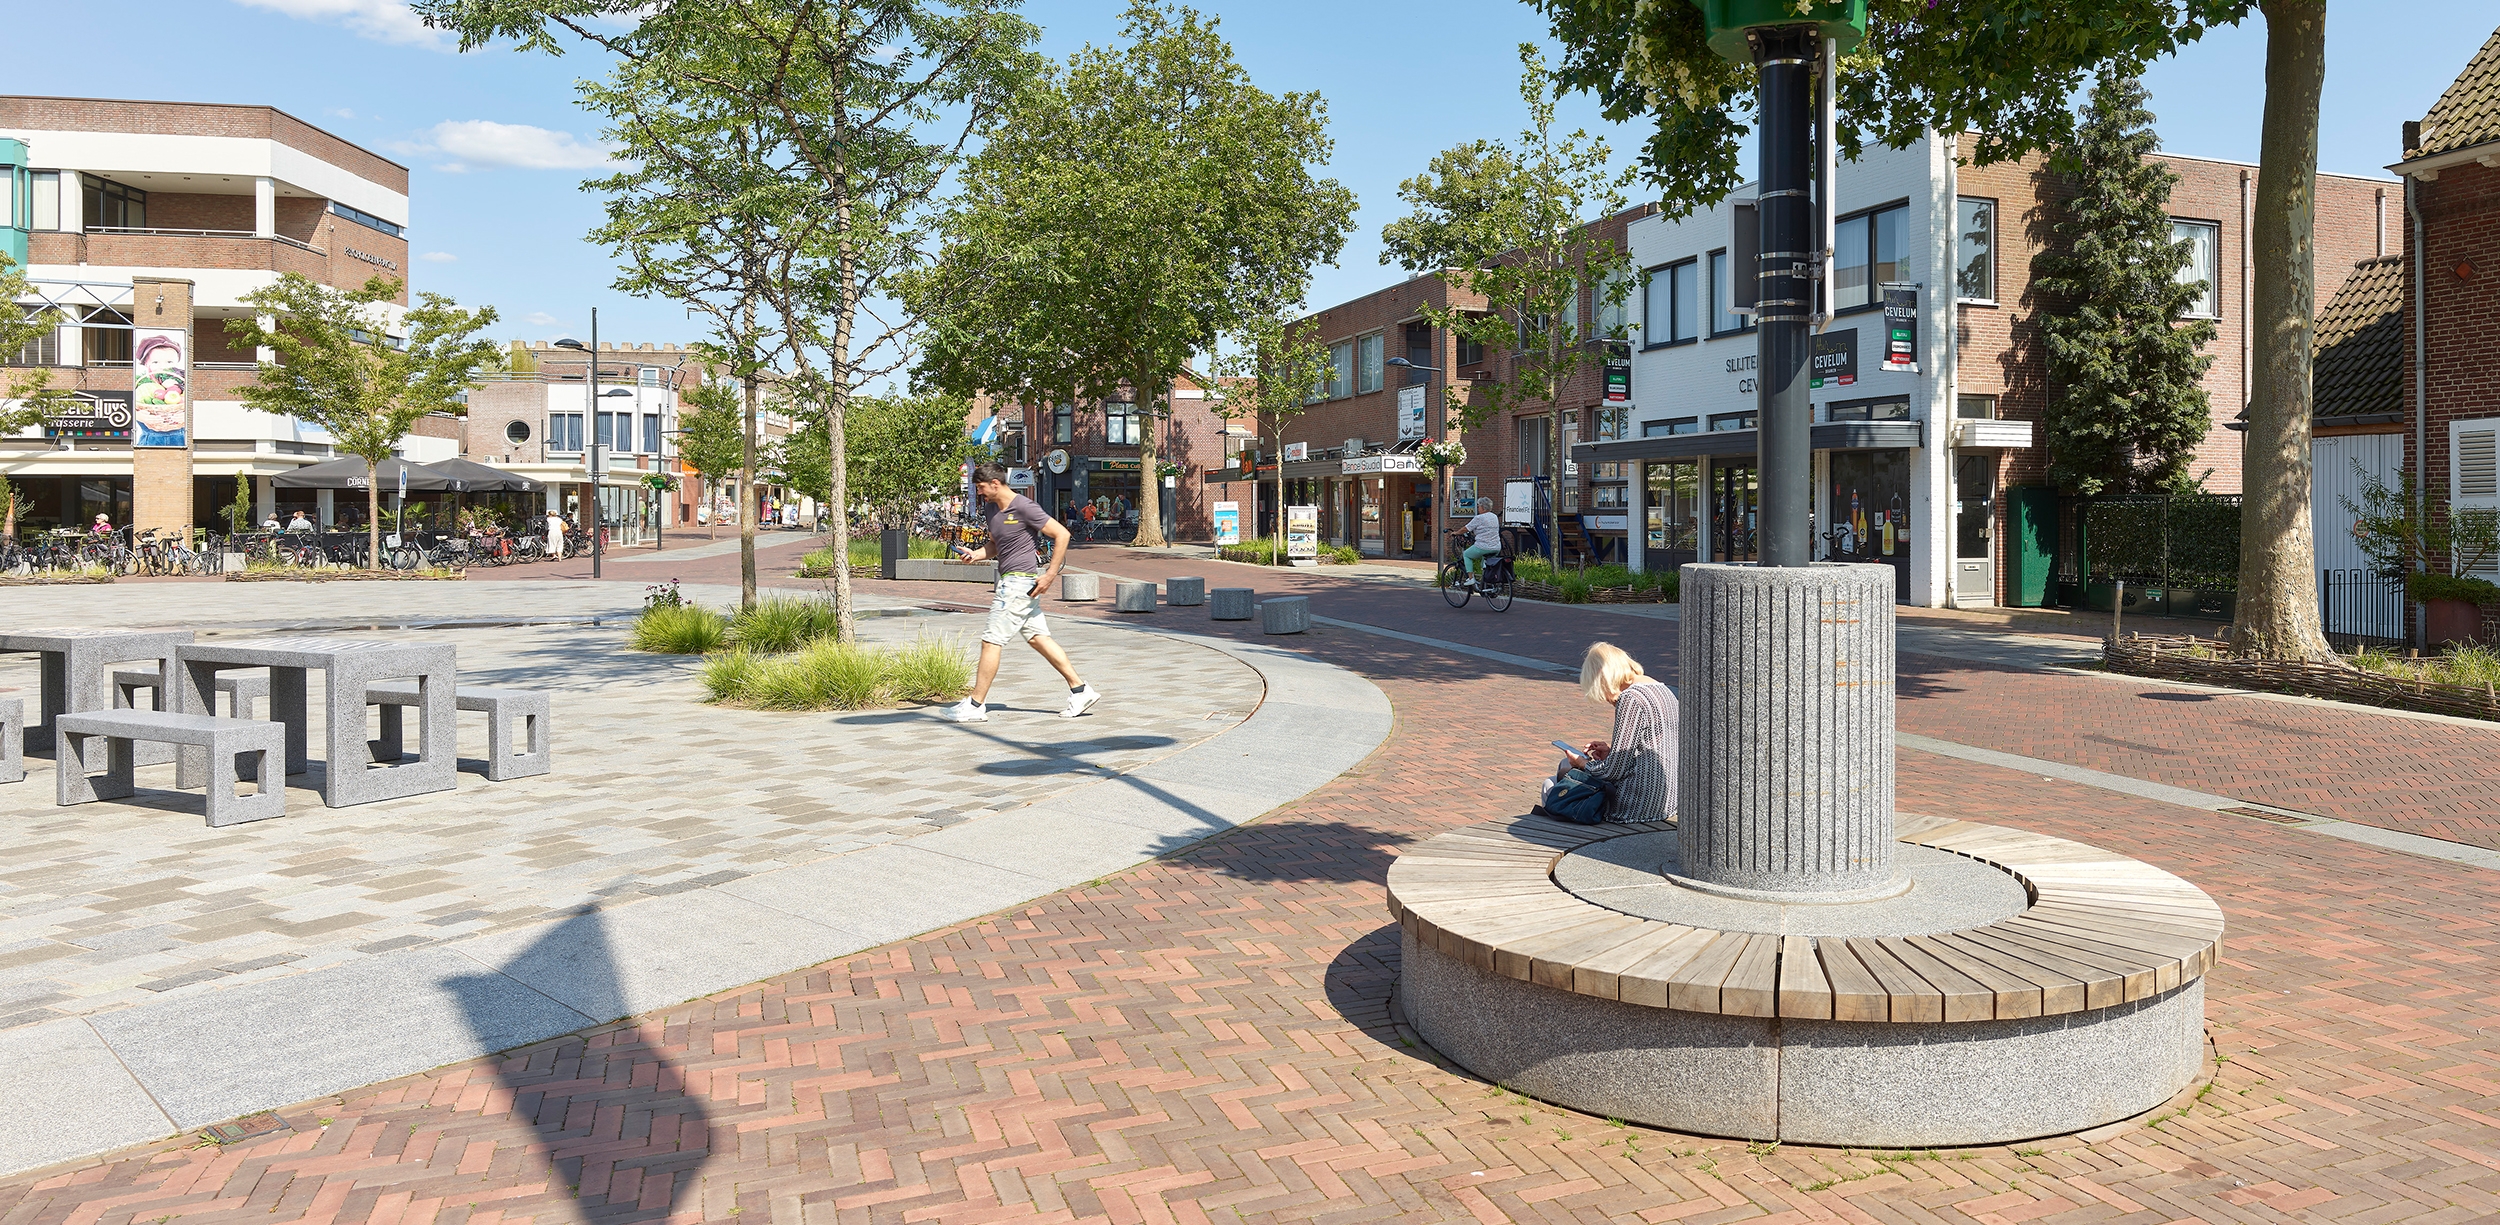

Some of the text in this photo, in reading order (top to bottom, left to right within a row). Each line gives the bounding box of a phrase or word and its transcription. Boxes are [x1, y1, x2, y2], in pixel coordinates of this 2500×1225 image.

[1885, 306, 1917, 318] CEVELUM
[1606, 358, 1631, 366] EVELUM
[1726, 355, 1758, 373] SLIJTE
[1814, 352, 1847, 369] CEVELUM
[1739, 378, 1758, 393] CEV
[44, 419, 94, 428] rasserie
